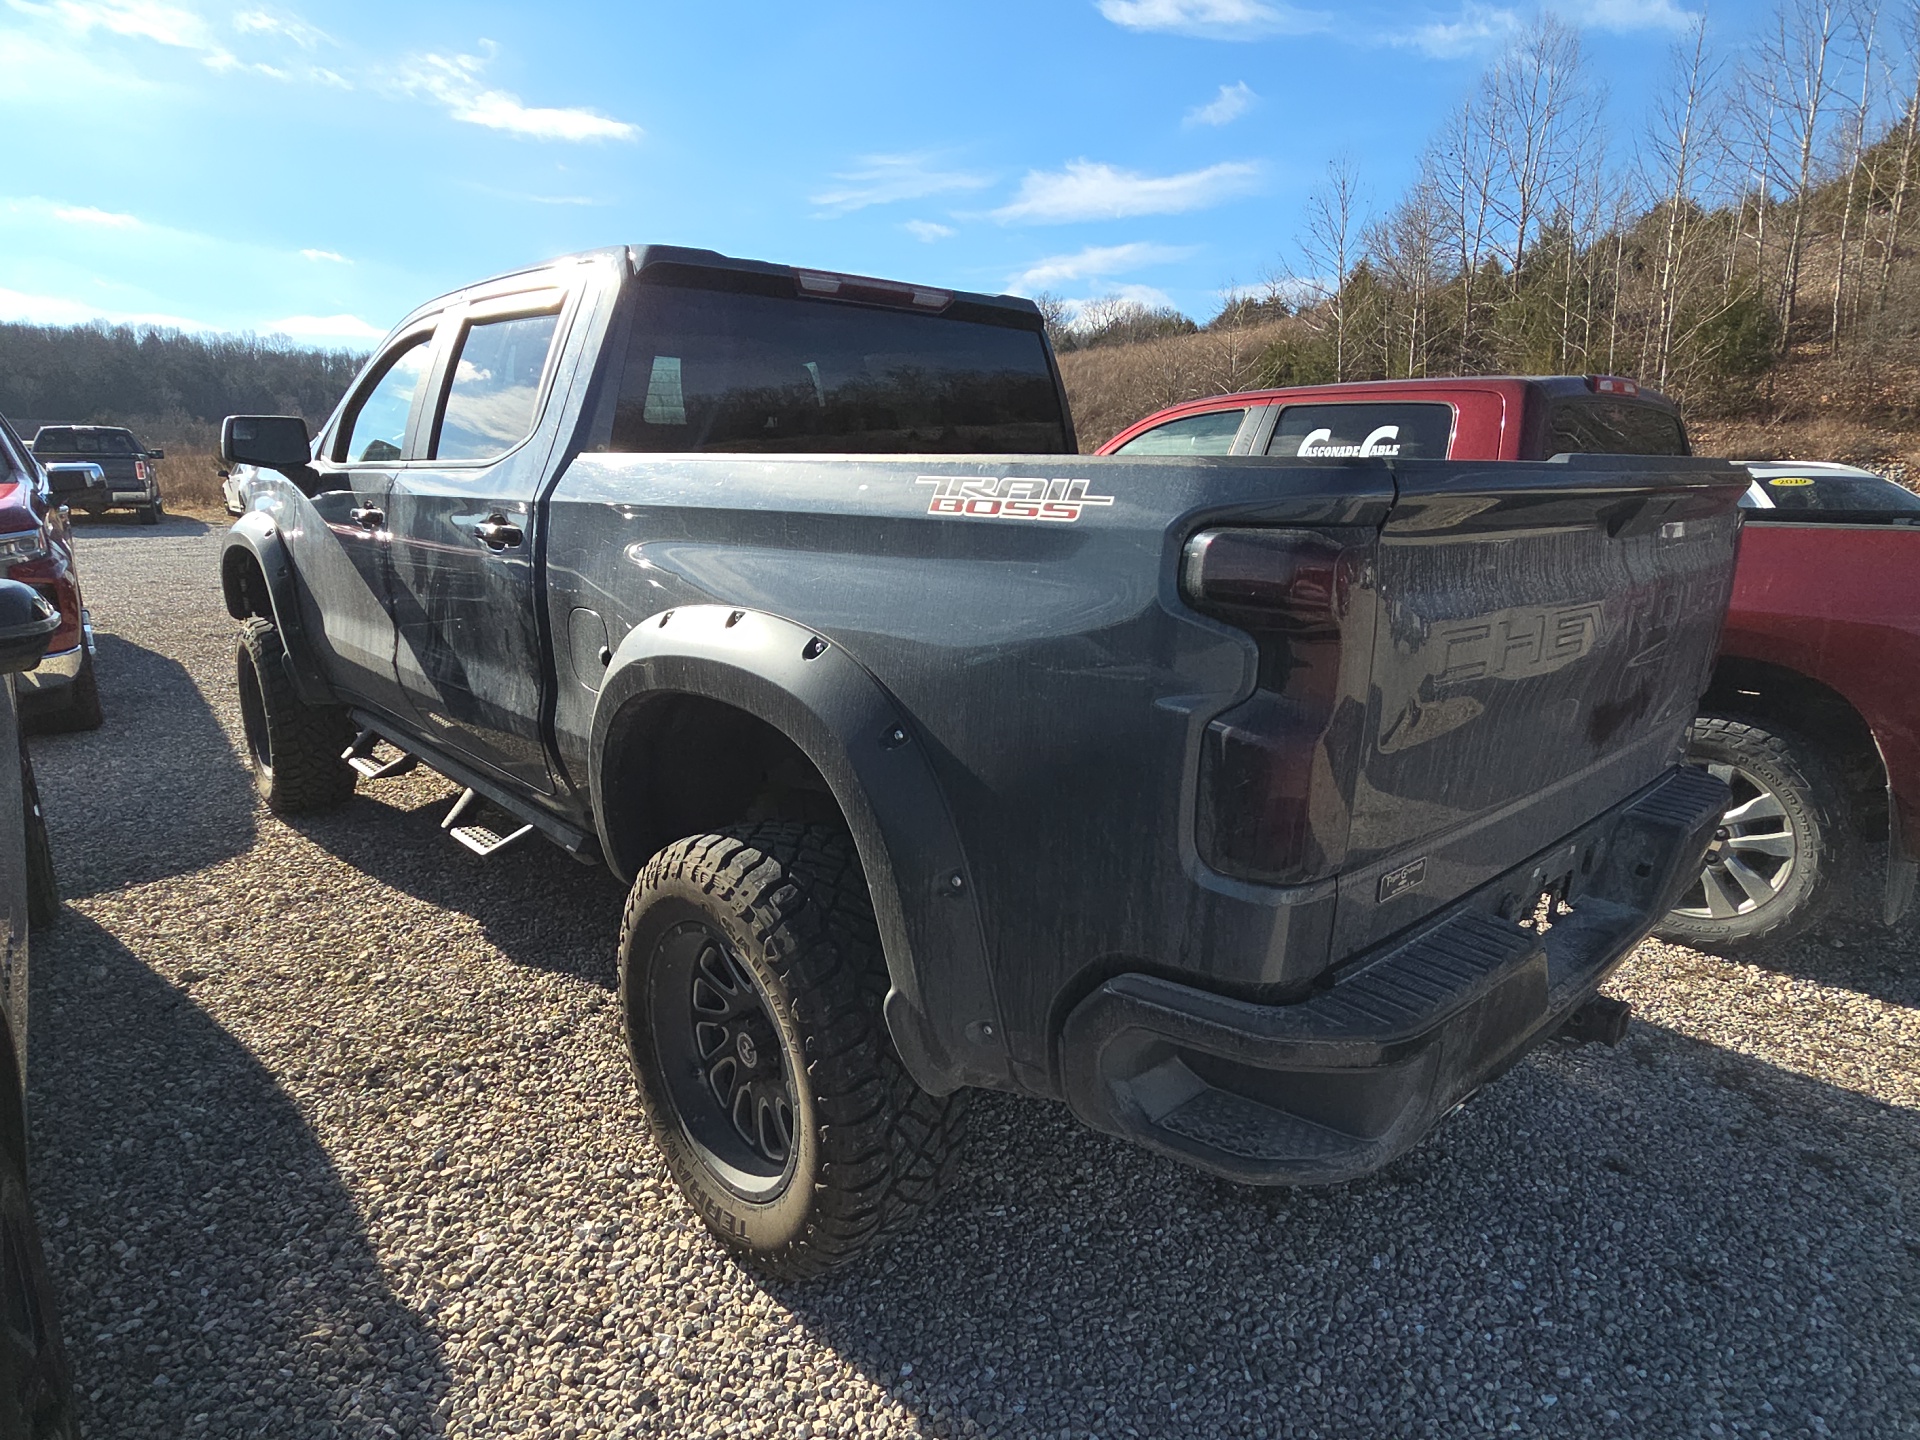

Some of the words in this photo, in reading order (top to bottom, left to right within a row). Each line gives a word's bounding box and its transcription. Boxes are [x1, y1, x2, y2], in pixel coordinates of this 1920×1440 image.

[1359, 425, 1401, 458] CABLE
[915, 475, 1115, 505] TRAIL
[1778, 478, 1807, 486] 2019
[927, 496, 1082, 522] BOSS
